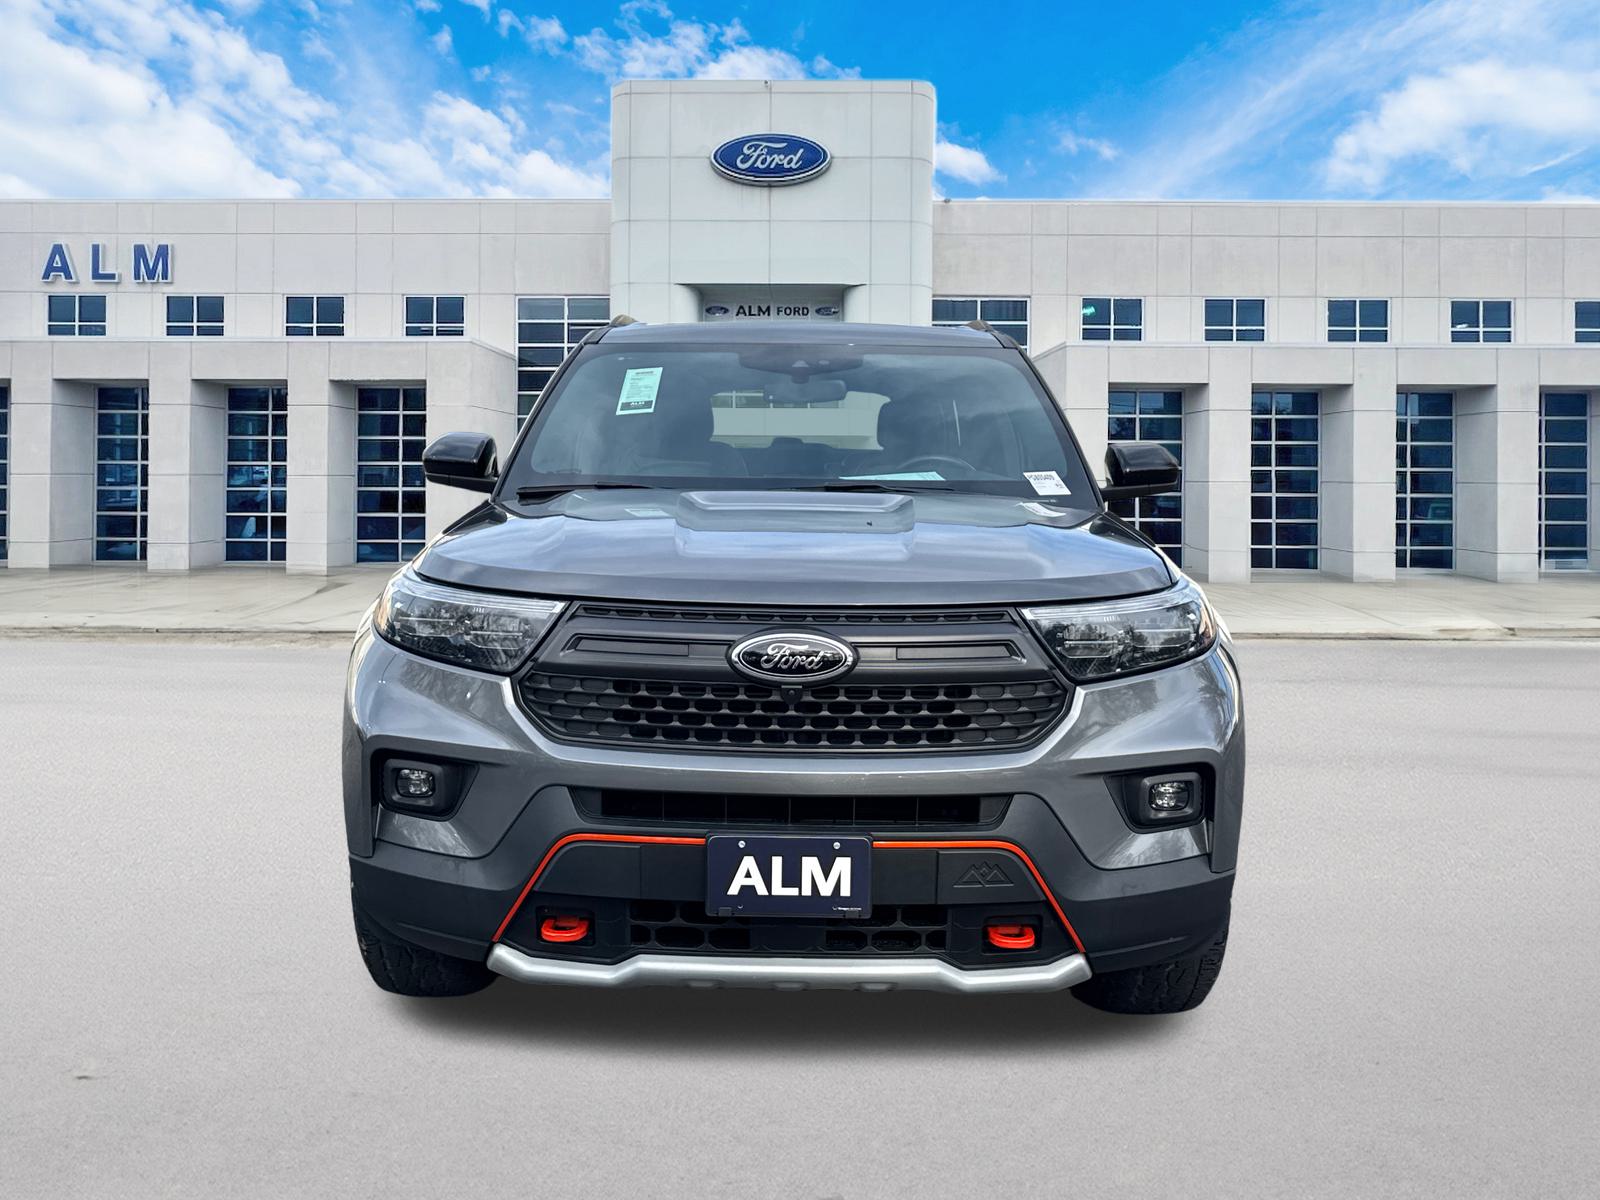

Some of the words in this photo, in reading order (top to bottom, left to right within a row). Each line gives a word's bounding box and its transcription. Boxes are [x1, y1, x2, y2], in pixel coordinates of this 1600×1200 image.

[736, 141, 804, 169] Ford
[41, 242, 172, 282] ALM
[735, 305, 771, 317] ALM
[776, 306, 810, 316] FORD
[760, 643, 824, 669] Ford
[726, 855, 852, 897] ALM
